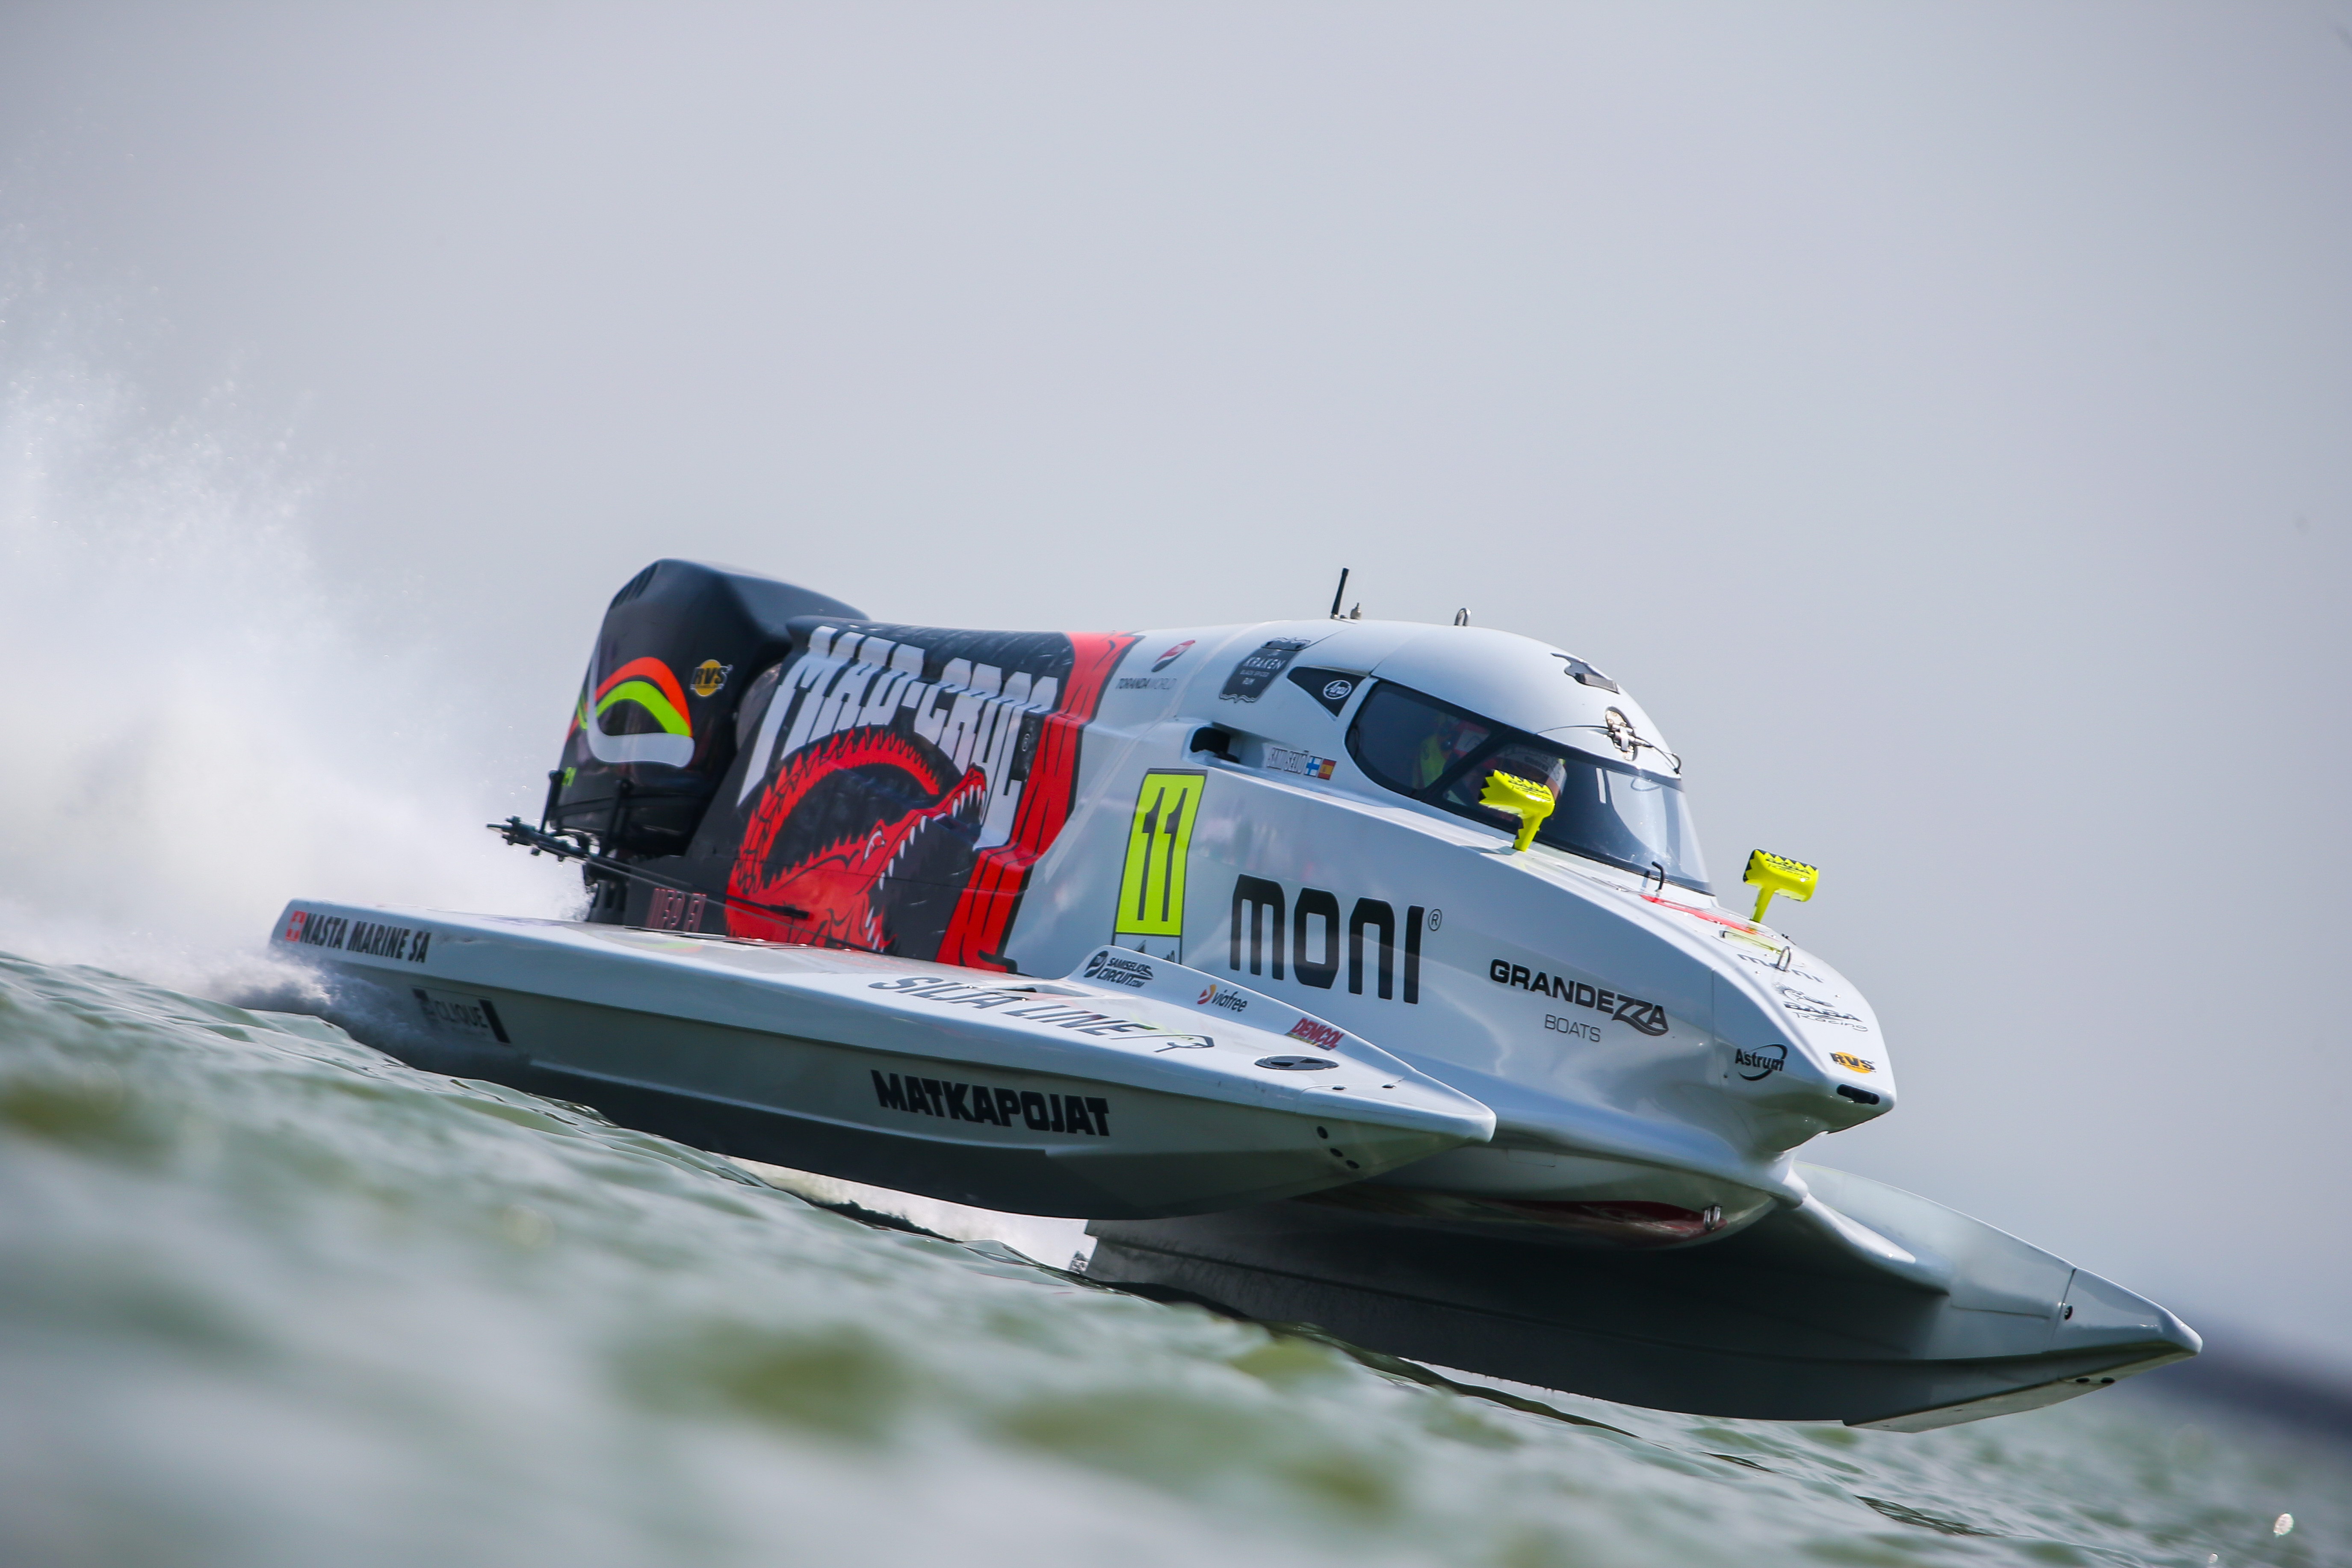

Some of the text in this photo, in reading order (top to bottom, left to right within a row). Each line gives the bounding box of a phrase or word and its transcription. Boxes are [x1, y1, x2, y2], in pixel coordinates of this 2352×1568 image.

[1243, 656, 1286, 670] KRAKEN
[692, 667, 727, 685] RVS
[737, 625, 1058, 851] MAD-CROC
[1137, 787, 1188, 922] 11
[1765, 857, 1811, 875] BABA
[300, 912, 431, 963] NASTA MARINE SA
[868, 977, 1160, 1035] SILJA LINE
[1211, 989, 1248, 1012] viafree
[1490, 958, 1669, 1036] GRANDEZZA
[1782, 1000, 1864, 1022] BABA
[1792, 1012, 1868, 1032] Racing
[1545, 1013, 1601, 1042] BOATS
[1735, 1048, 1785, 1071] Astrum
[1829, 1052, 1876, 1070] RVS
[871, 1069, 1110, 1136] MATKAPOJAT
